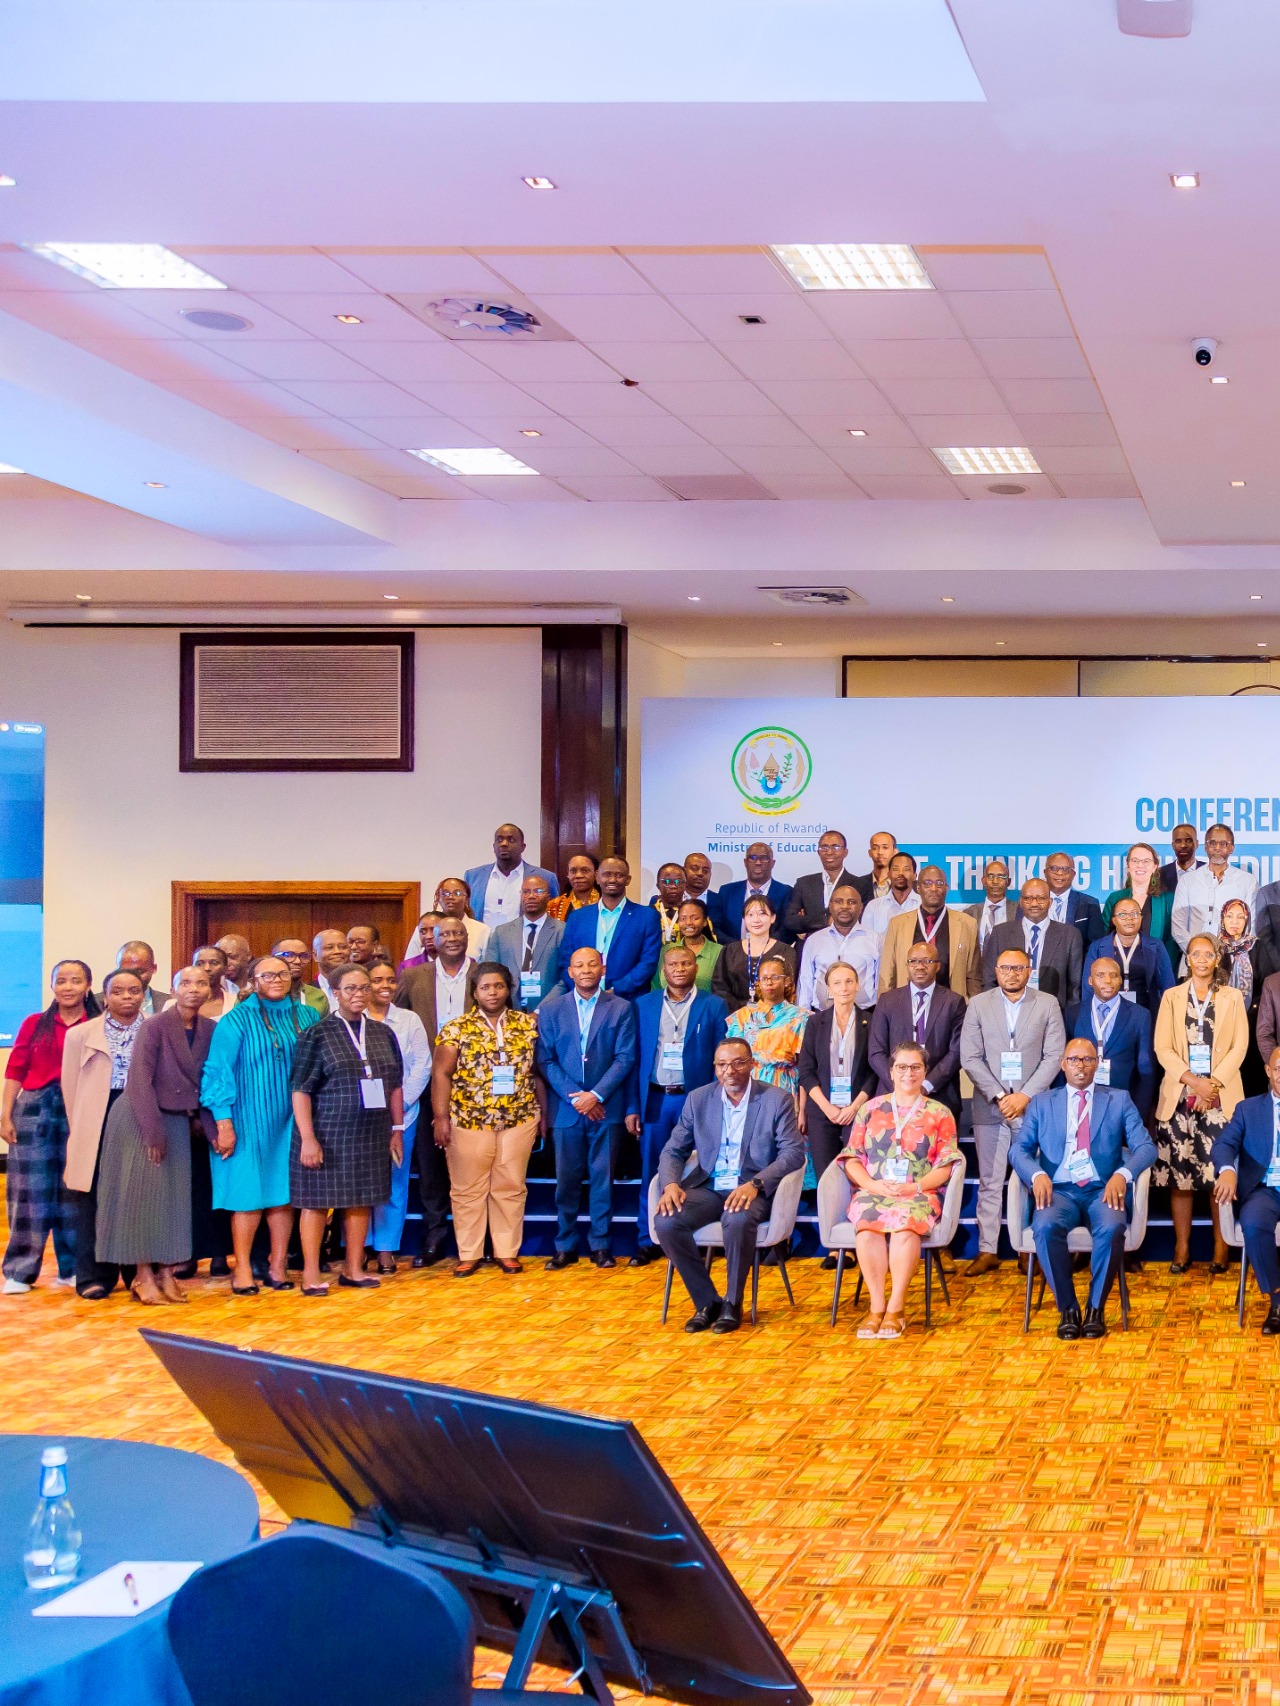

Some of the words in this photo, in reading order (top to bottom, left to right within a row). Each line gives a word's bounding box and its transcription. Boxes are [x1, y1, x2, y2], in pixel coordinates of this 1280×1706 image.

[715, 823, 764, 835] Republic
[768, 822, 780, 833] of
[783, 822, 828, 833] Rwanda
[708, 842, 750, 852] Ministr
[777, 842, 817, 852] Educat
